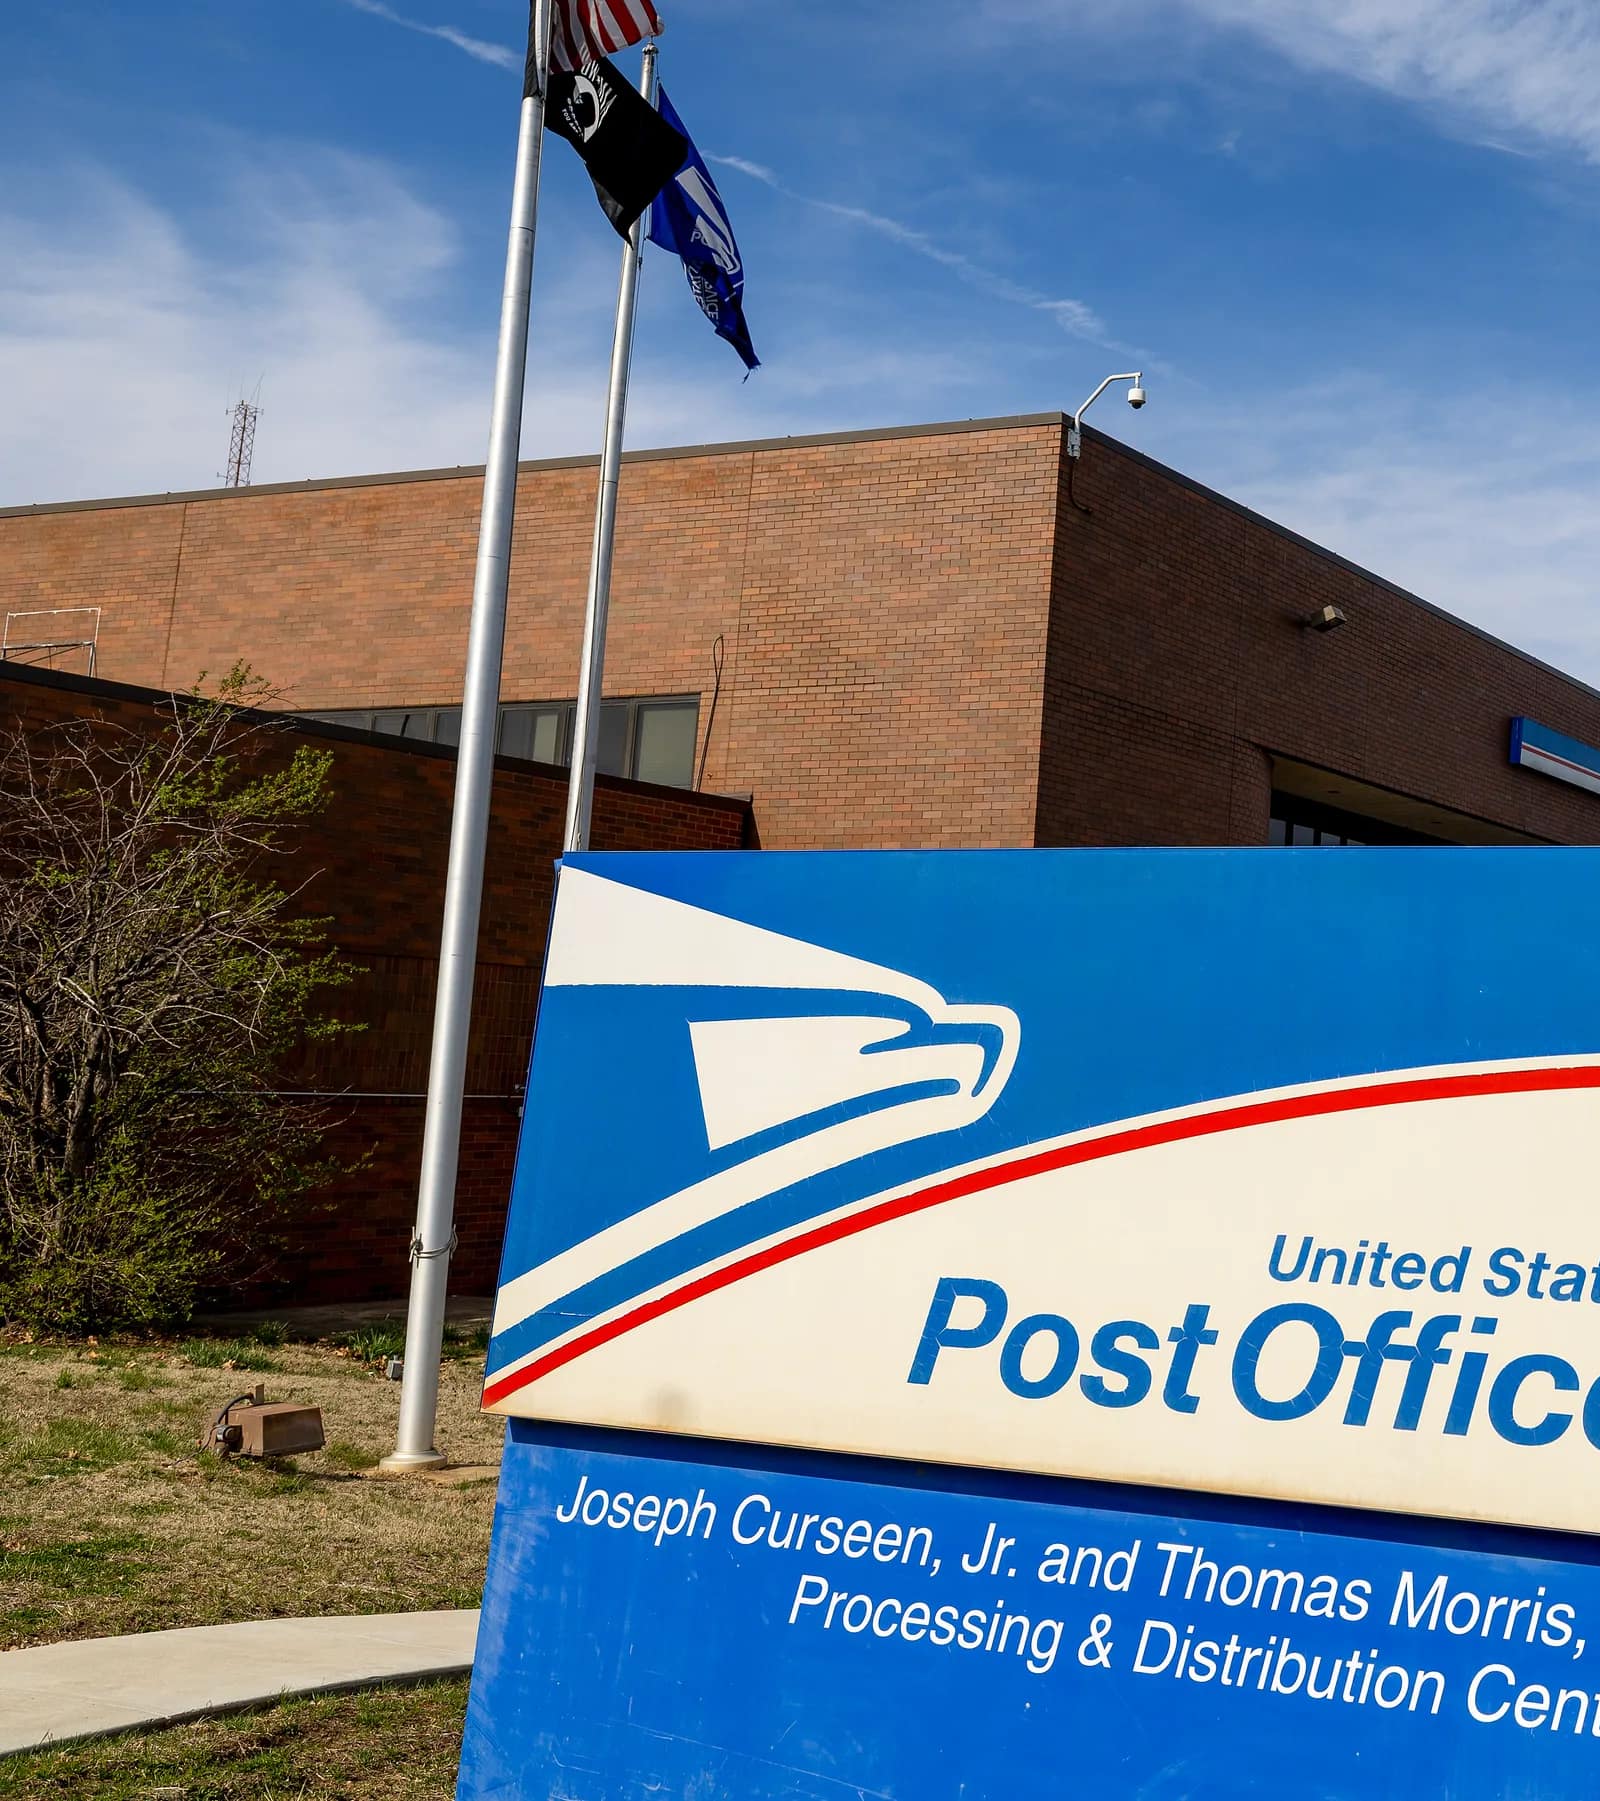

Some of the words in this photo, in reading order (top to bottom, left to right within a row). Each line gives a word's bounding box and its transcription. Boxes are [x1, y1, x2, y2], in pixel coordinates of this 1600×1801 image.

[1268, 1234, 1472, 1293] United
[907, 1277, 1219, 1414] Post
[555, 1475, 718, 1547] Joseph
[732, 1494, 941, 1577] Curseen,
[961, 1522, 1017, 1578] Jr.
[1037, 1539, 1141, 1592] and
[1157, 1542, 1372, 1621] Thomas
[1389, 1571, 1586, 1660] Morris,
[788, 1574, 1065, 1674] Processing
[1077, 1613, 1113, 1668] &
[1132, 1619, 1445, 1714] Distribution
